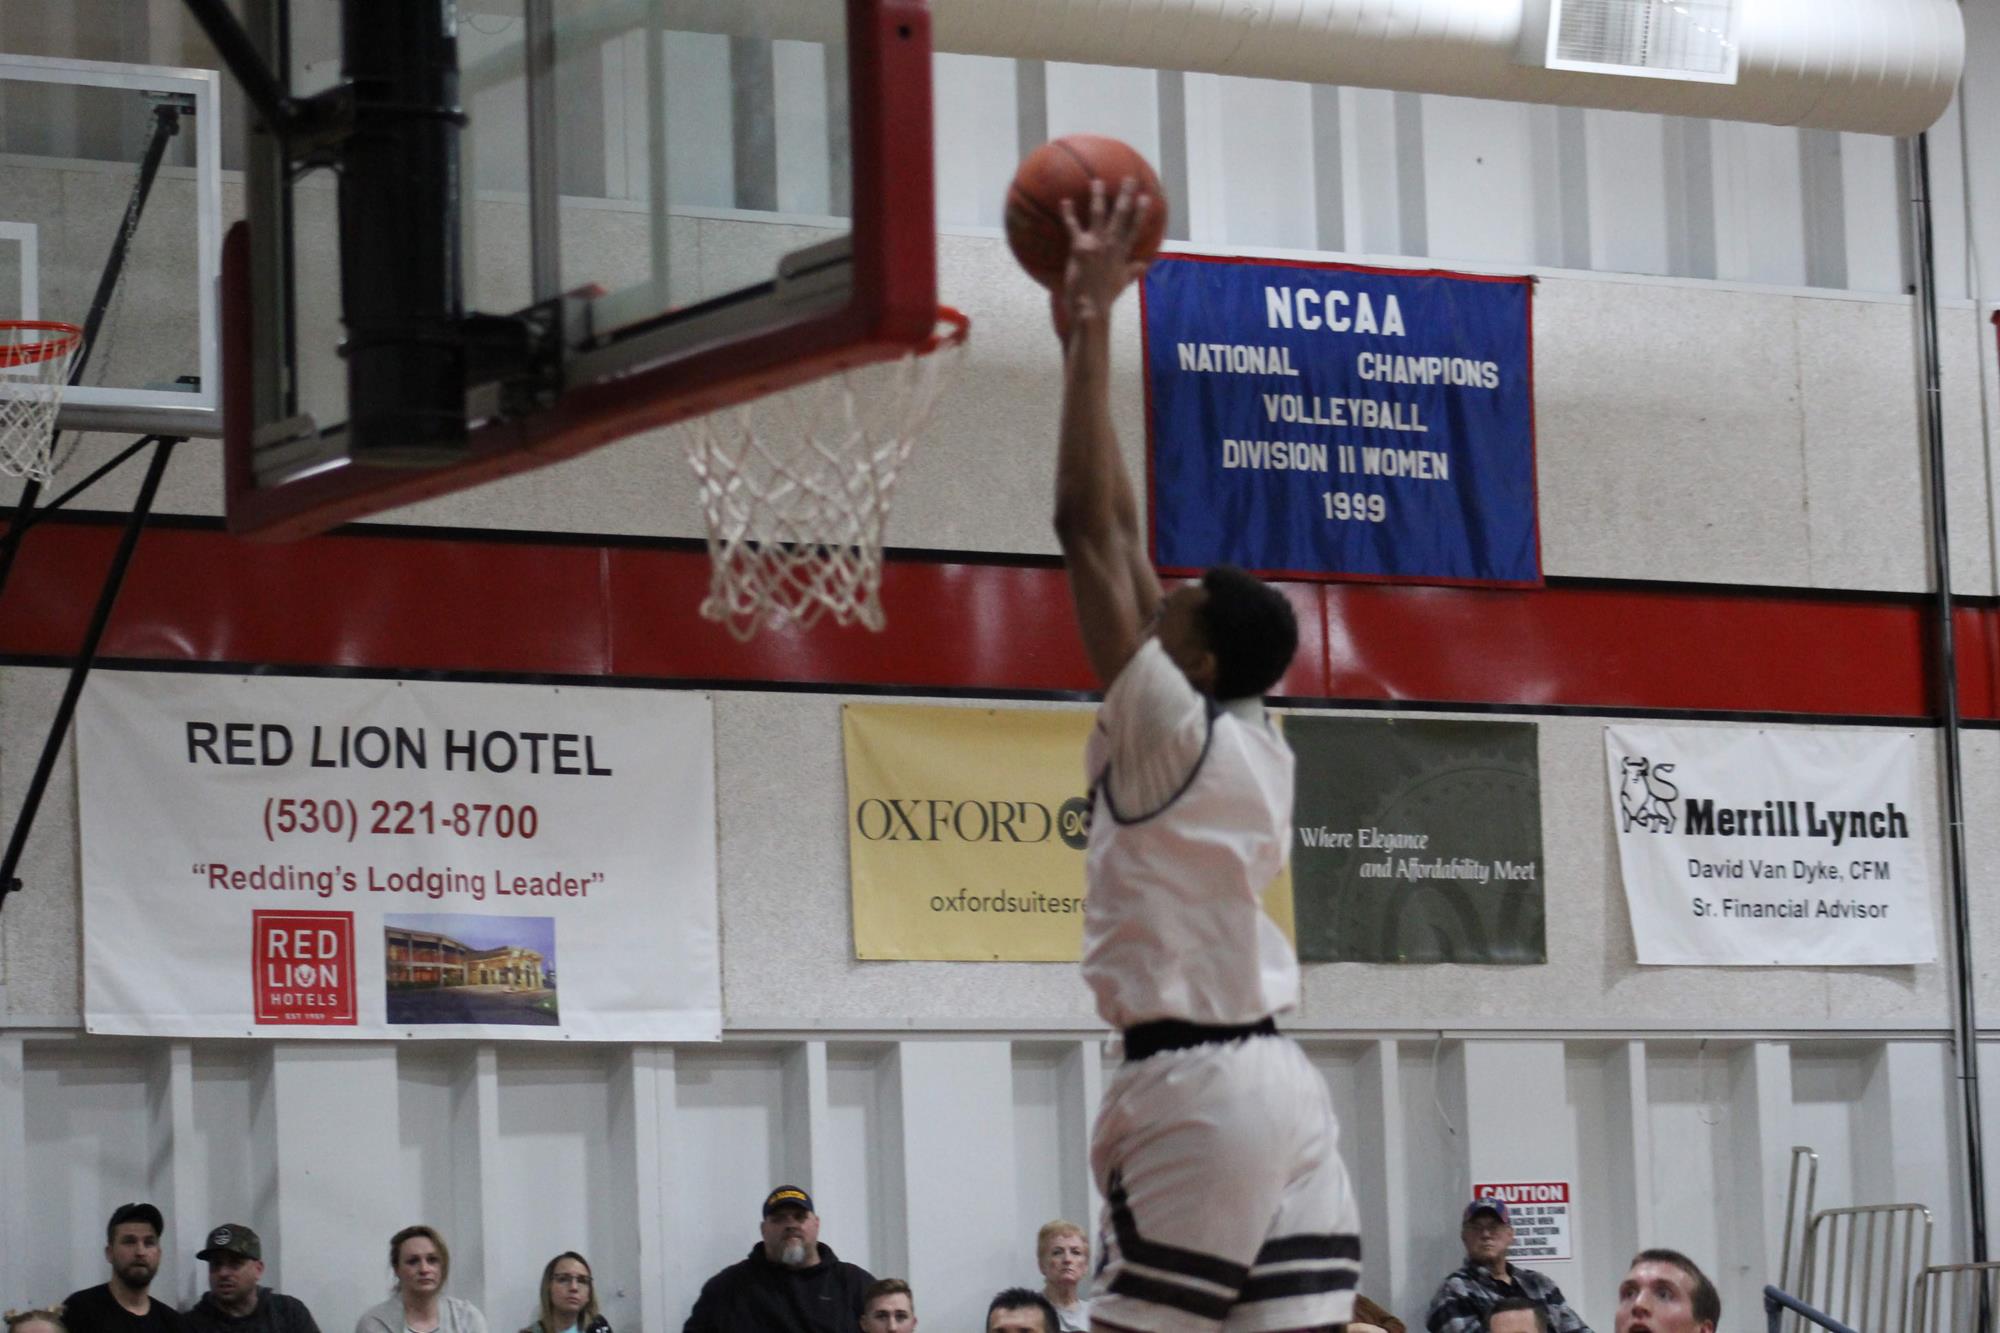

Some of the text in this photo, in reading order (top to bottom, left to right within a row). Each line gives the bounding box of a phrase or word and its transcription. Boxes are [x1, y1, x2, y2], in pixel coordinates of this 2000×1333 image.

[1264, 286, 1406, 336] NCCAA
[1177, 343, 1499, 389] NATIONAL CHAMPIONS
[1263, 394, 1428, 432] VOLLEYBALL
[1222, 440, 1449, 480] DIVISION II WOMEN
[1323, 492, 1387, 522] 1999
[186, 722, 613, 777] RED LION HOTEL
[264, 798, 539, 842] (530) 221-8700
[857, 798, 1053, 843] OXFORD
[1685, 799, 1909, 846] Merrill Lynch
[1300, 826, 1429, 853] Where Elegance
[369, 866, 486, 901] Lodging
[1359, 857, 1536, 884] and Affordability Meet
[1688, 859, 1891, 884] David Van Dyke, CFM
[1693, 898, 1888, 919] Sr. Financial Advisor
[268, 929, 338, 959] RED
[268, 963, 338, 988] LION
[270, 993, 338, 1006] HOTELS
[1481, 1185, 1563, 1201] CAUTION
